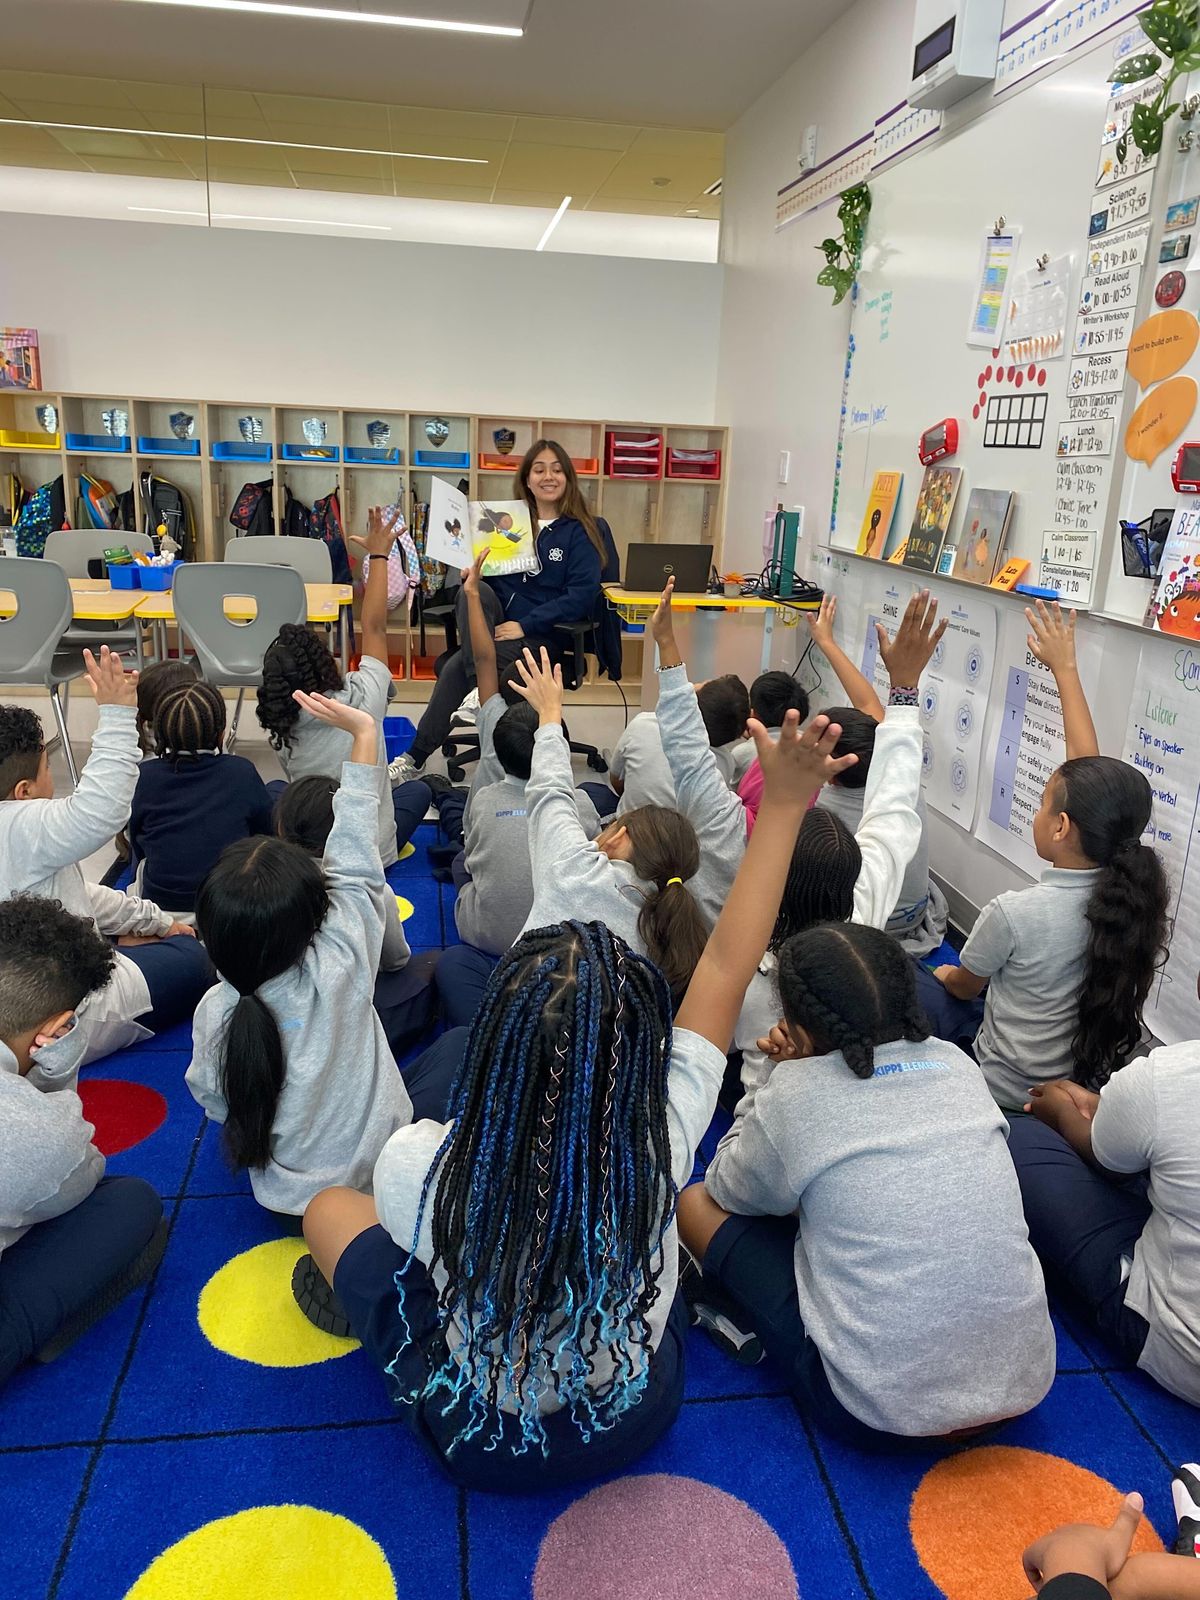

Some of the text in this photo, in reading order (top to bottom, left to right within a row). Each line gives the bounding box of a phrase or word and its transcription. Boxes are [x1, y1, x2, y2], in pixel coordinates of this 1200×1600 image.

[1114, 94, 1141, 112] Morning
[1109, 186, 1136, 206] Science
[1090, 233, 1125, 250] Independent
[1095, 269, 1130, 287] Read Aloud
[1104, 311, 1129, 322] Workshop
[1089, 355, 1111, 367] Recess
[1077, 425, 1095, 436] Lunch
[1052, 533, 1088, 541] Calm Classroom
[1042, 565, 1091, 581] Constellation Meeting
[882, 603, 898, 618] SHINE
[1026, 651, 1036, 667] Be
[1028, 679, 1040, 692] Stay
[1027, 693, 1043, 706] follow
[1145, 690, 1178, 726] Listener
[1024, 715, 1032, 727] Try
[1032, 720, 1044, 731] your
[1044, 723, 1056, 738] best
[1021, 730, 1039, 745] engage
[1139, 727, 1152, 748] Eyes
[1154, 738, 1161, 747] on
[1017, 751, 1053, 775] Act safely and
[1134, 752, 1164, 776] Building on
[1016, 766, 1028, 776] your
[1014, 779, 1026, 790] each
[1012, 793, 1032, 811] Respect
[1010, 808, 1026, 823] others
[1009, 822, 1023, 836] space.
